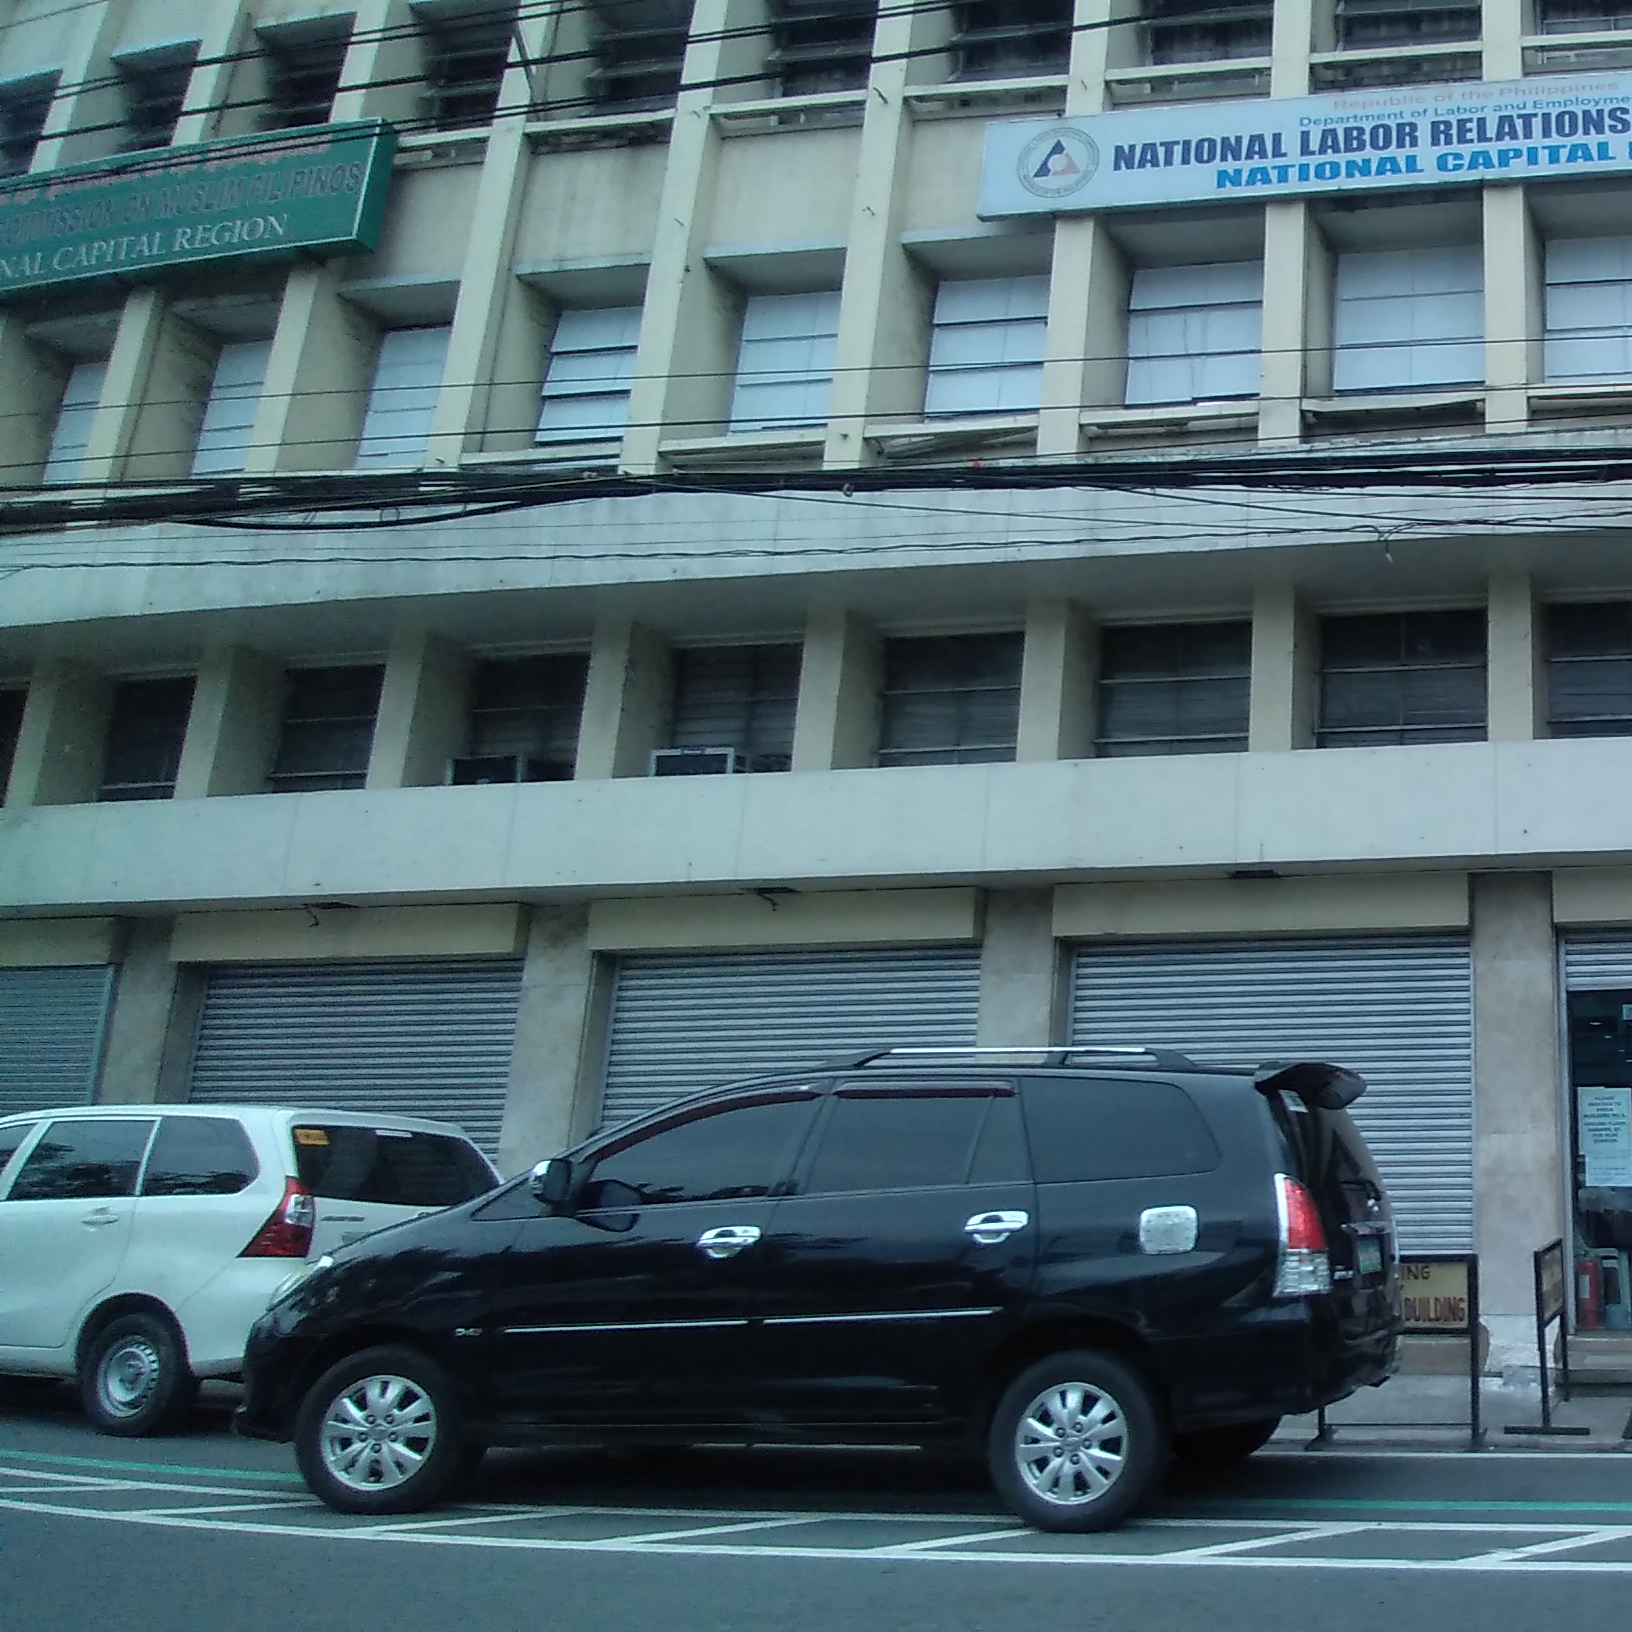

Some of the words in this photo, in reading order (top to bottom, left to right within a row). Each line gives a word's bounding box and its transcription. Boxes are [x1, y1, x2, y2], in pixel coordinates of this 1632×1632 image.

[1299, 111, 1405, 128] Department
[1411, 107, 1429, 118] of
[1434, 102, 1488, 116] Labor
[1493, 101, 1527, 113] and
[1333, 95, 1426, 111] Republic
[1434, 90, 1456, 102] of
[1461, 88, 1493, 100] the
[1499, 80, 1619, 98] Philippines
[1112, 132, 1288, 171] NATIONAL
[1300, 120, 1420, 157] LABOR
[1430, 106, 1631, 148] RELATIONS
[1216, 154, 1424, 189] NATIONAL
[1436, 141, 1617, 173] CAPITAL
[53, 231, 165, 271] CAPITAL
[173, 213, 288, 252] REGION
